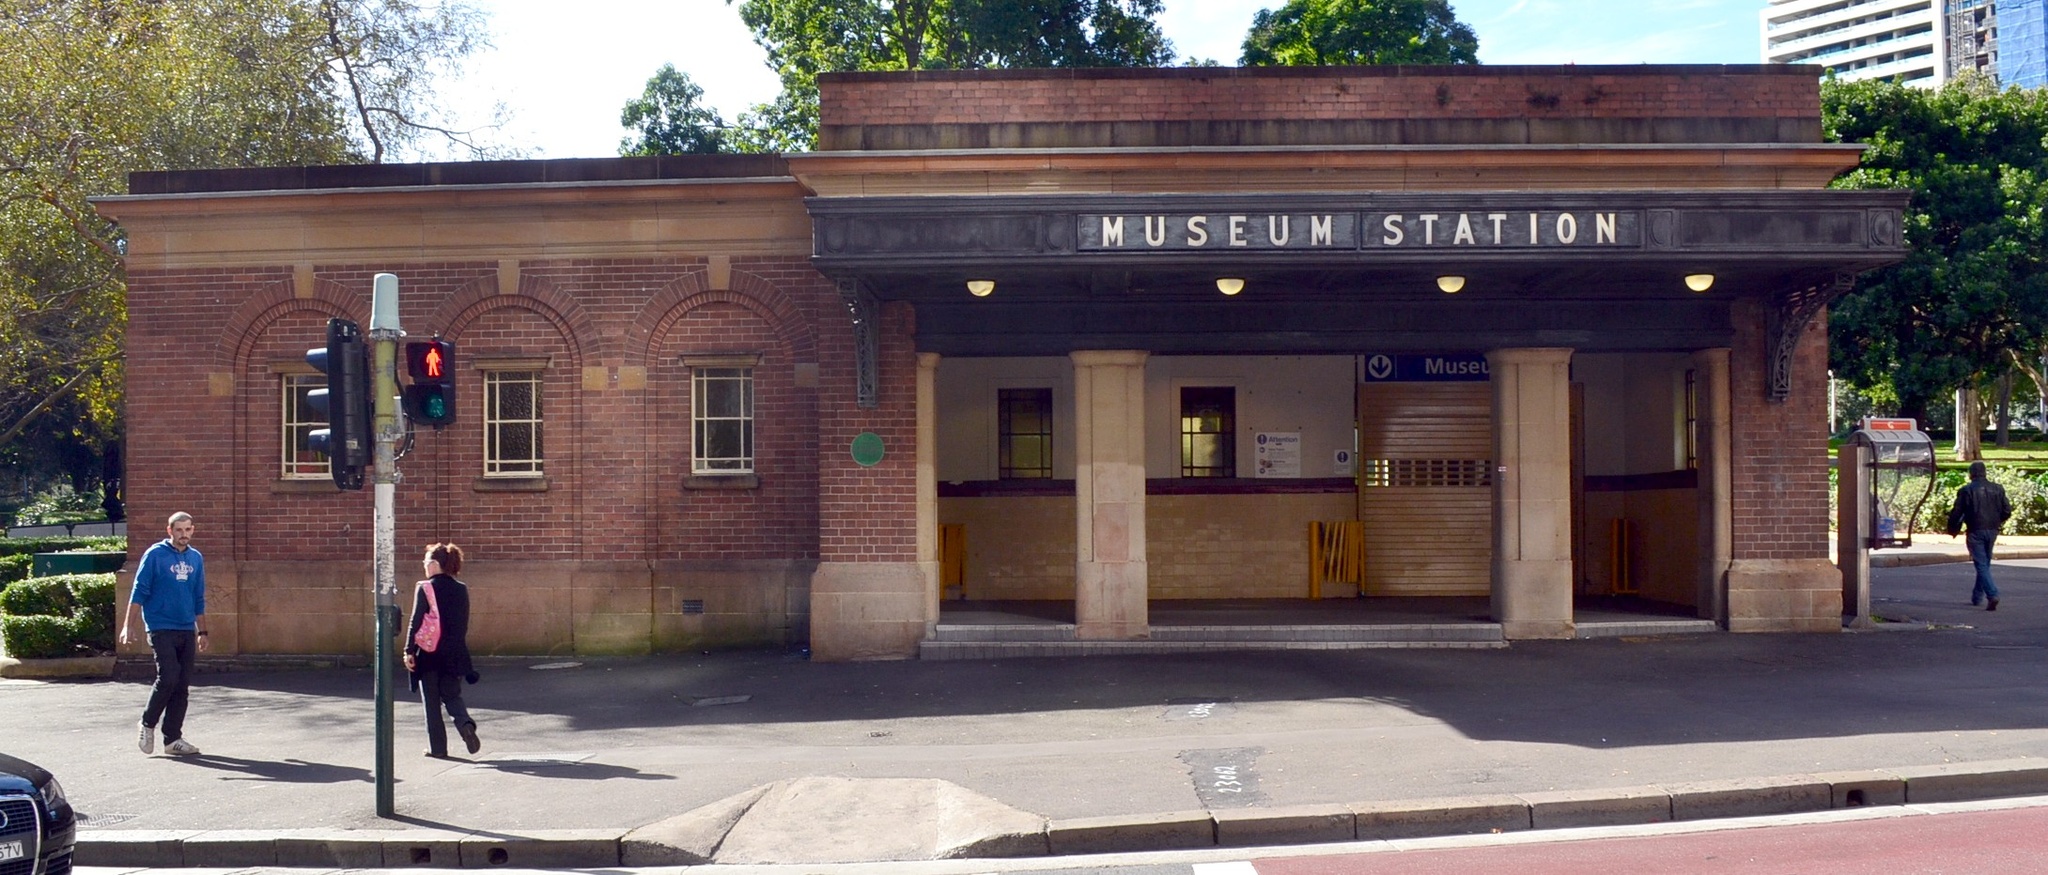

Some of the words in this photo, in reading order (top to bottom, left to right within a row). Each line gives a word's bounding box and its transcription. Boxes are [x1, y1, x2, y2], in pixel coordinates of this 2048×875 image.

[1102, 216, 1333, 247] MUSEUM
[1383, 213, 1617, 246] STATION
[1425, 357, 1490, 375] Museu
